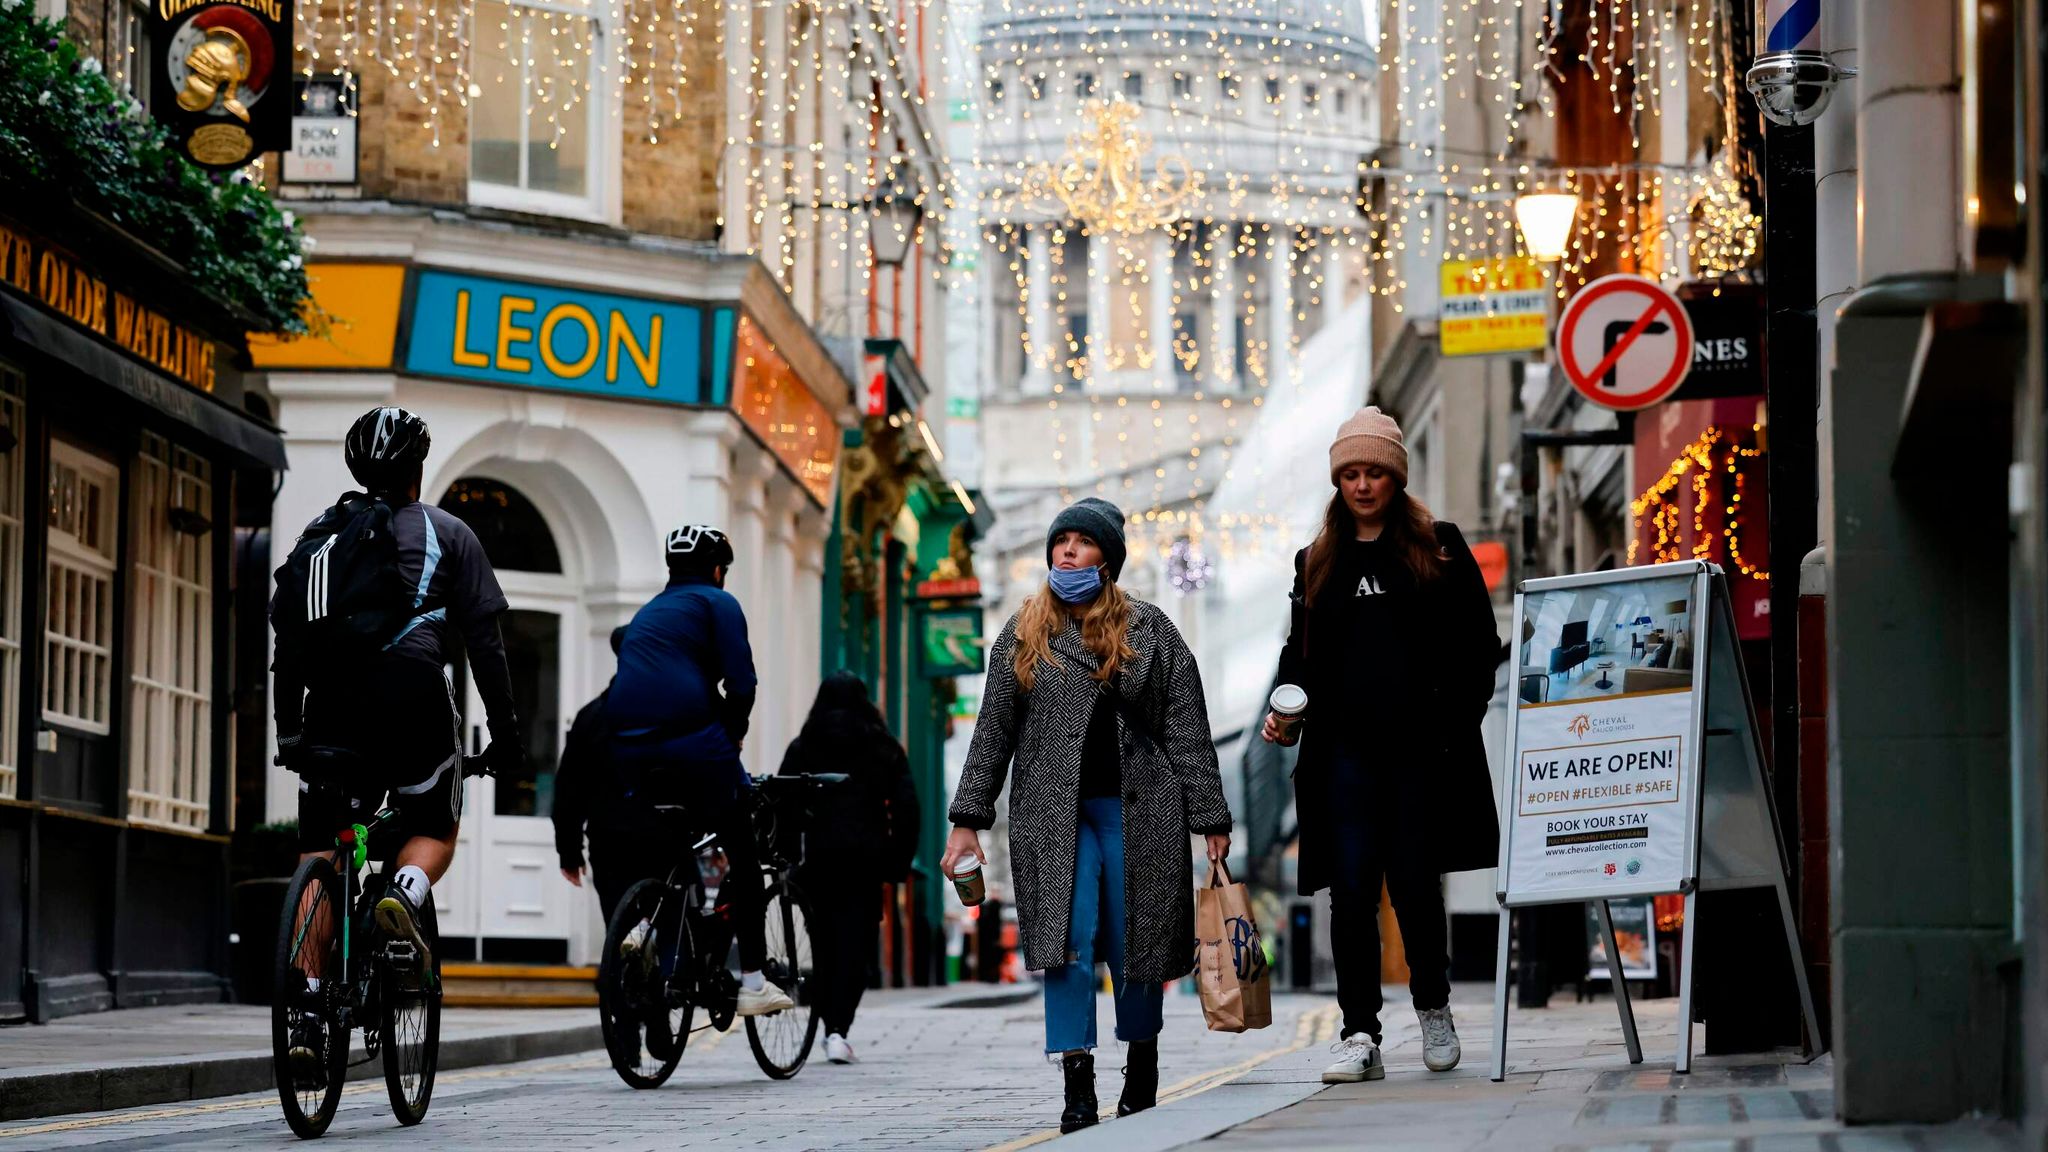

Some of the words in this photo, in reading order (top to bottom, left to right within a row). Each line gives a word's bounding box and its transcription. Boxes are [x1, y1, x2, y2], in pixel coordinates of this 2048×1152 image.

[300, 128, 339, 141] BOW
[298, 145, 340, 158] LANE
[39, 250, 107, 335] OLDE
[114, 291, 216, 393] WATLING
[452, 290, 663, 388] LEON
[1695, 337, 1748, 362] NES
[1592, 716, 1627, 727] CHEVAL
[1592, 726, 1614, 734] CALICO
[1528, 761, 1559, 781] WE
[1564, 757, 1602, 778] ARE
[1607, 750, 1673, 773] OPEN!
[1527, 789, 1569, 804] #OPEN
[1572, 783, 1632, 801] #FLEXIBLE
[1635, 780, 1672, 794] #SAFE
[1547, 819, 1580, 833] BOOK
[1583, 816, 1616, 829] YOUR
[1618, 813, 1648, 826] STAY
[1545, 841, 1647, 856] www.chevalcollection.com
